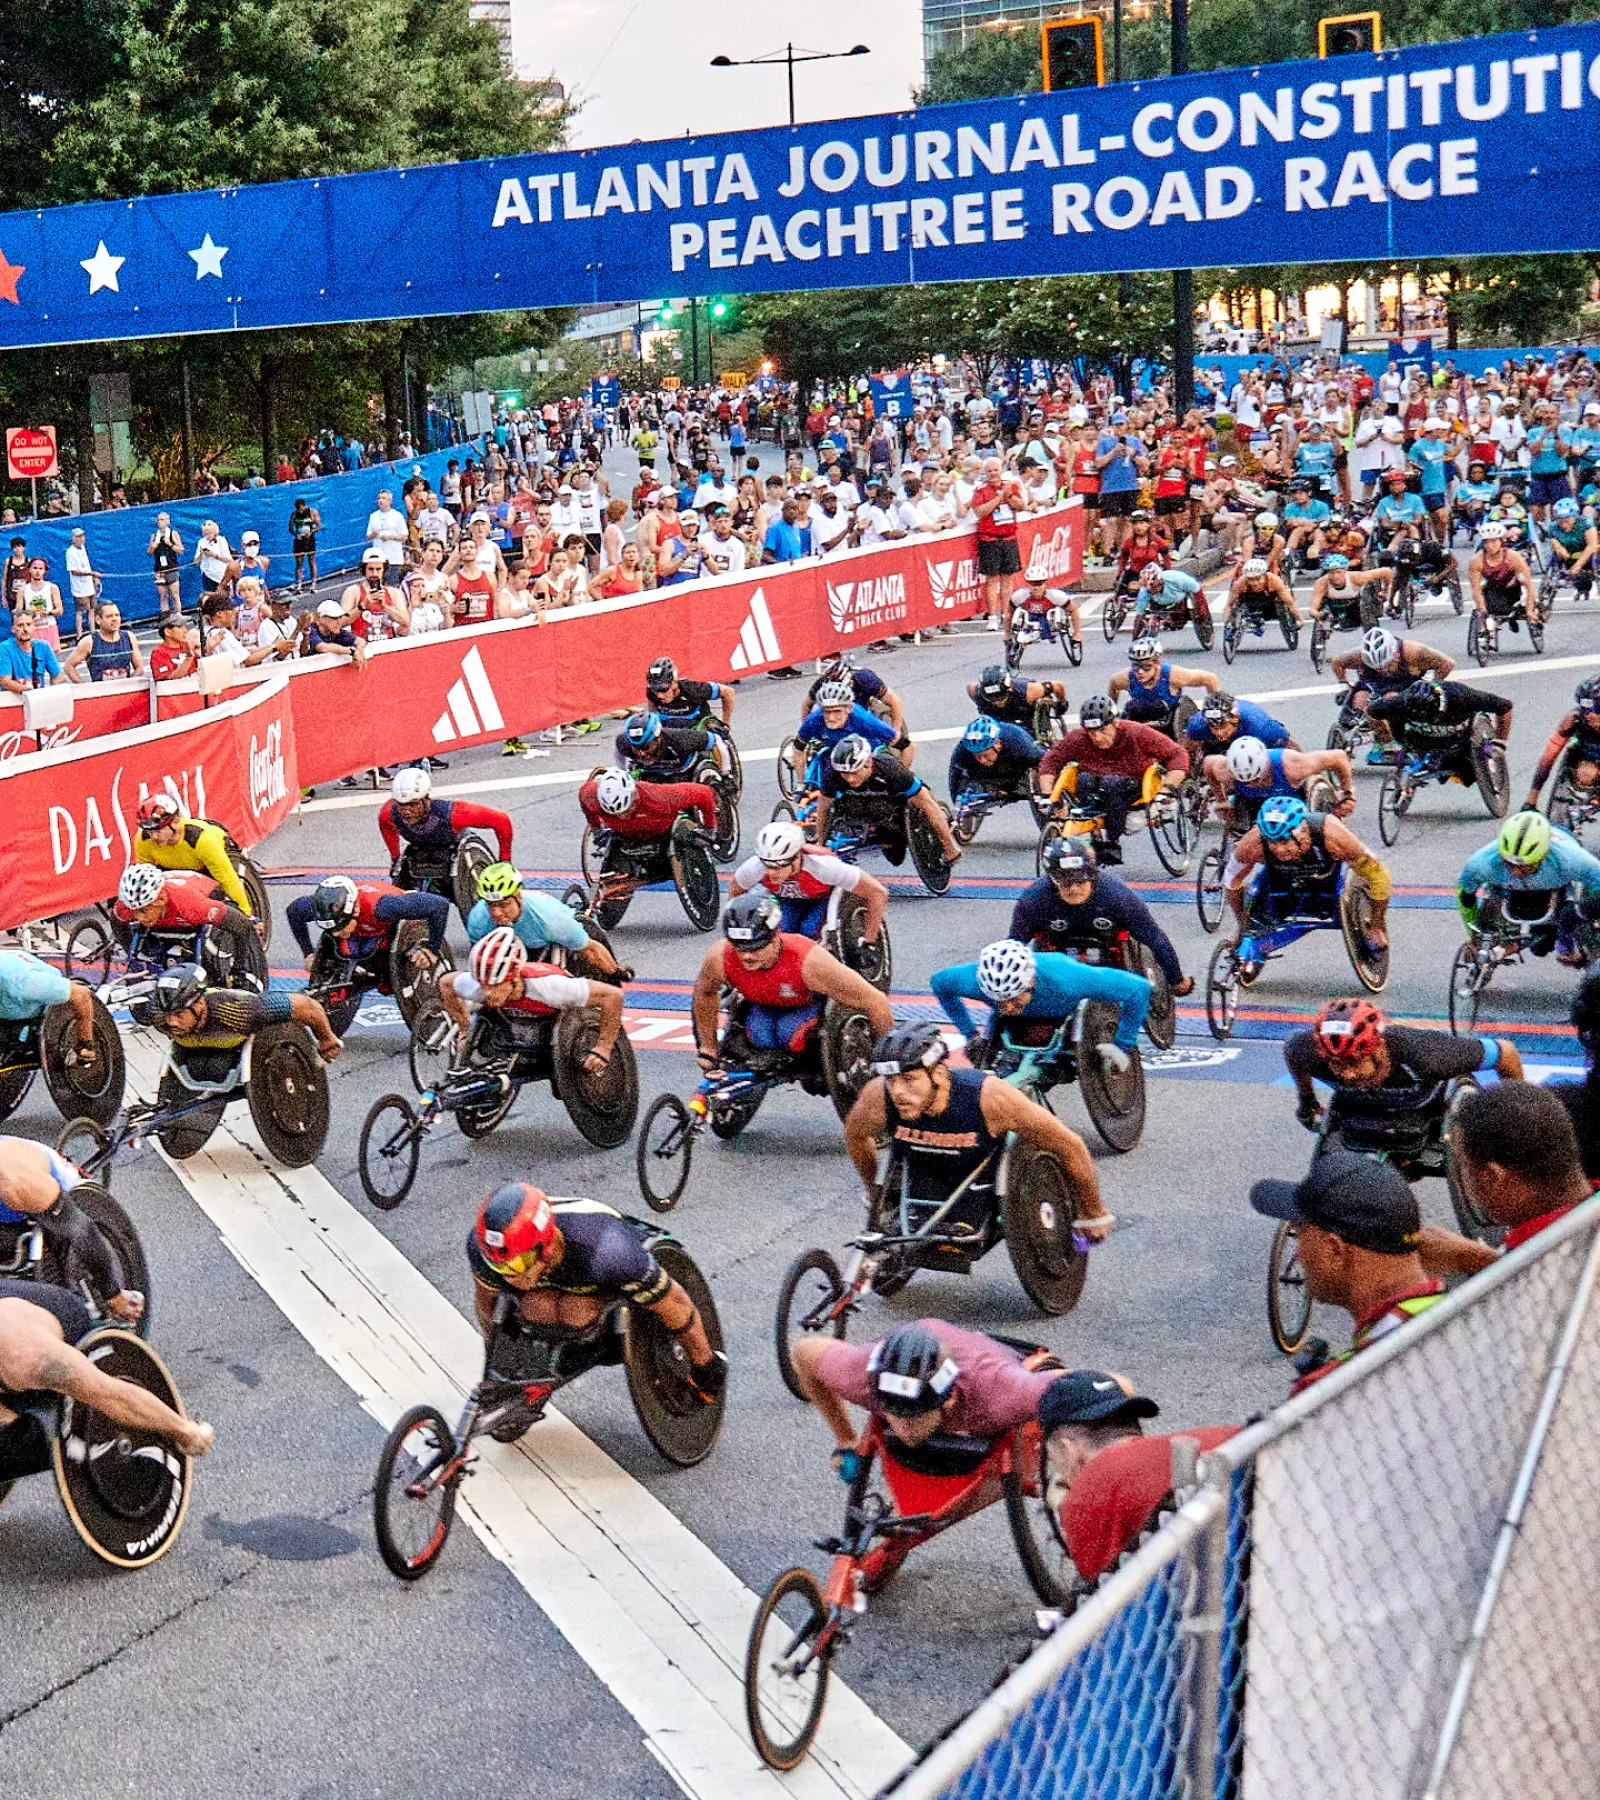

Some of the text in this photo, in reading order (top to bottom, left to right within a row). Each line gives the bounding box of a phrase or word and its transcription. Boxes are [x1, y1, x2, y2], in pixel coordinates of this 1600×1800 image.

[492, 49, 1600, 228] ATLANTA JOURNAL-CONSTITUTI
[670, 137, 1480, 272] PEACHTREE ROAD RACE
[887, 400, 901, 417] B
[14, 436, 48, 446] DO NOT
[19, 458, 46, 468] ENTER
[855, 573, 905, 614] ATLANTA
[855, 605, 907, 629] TRACK CLUB
